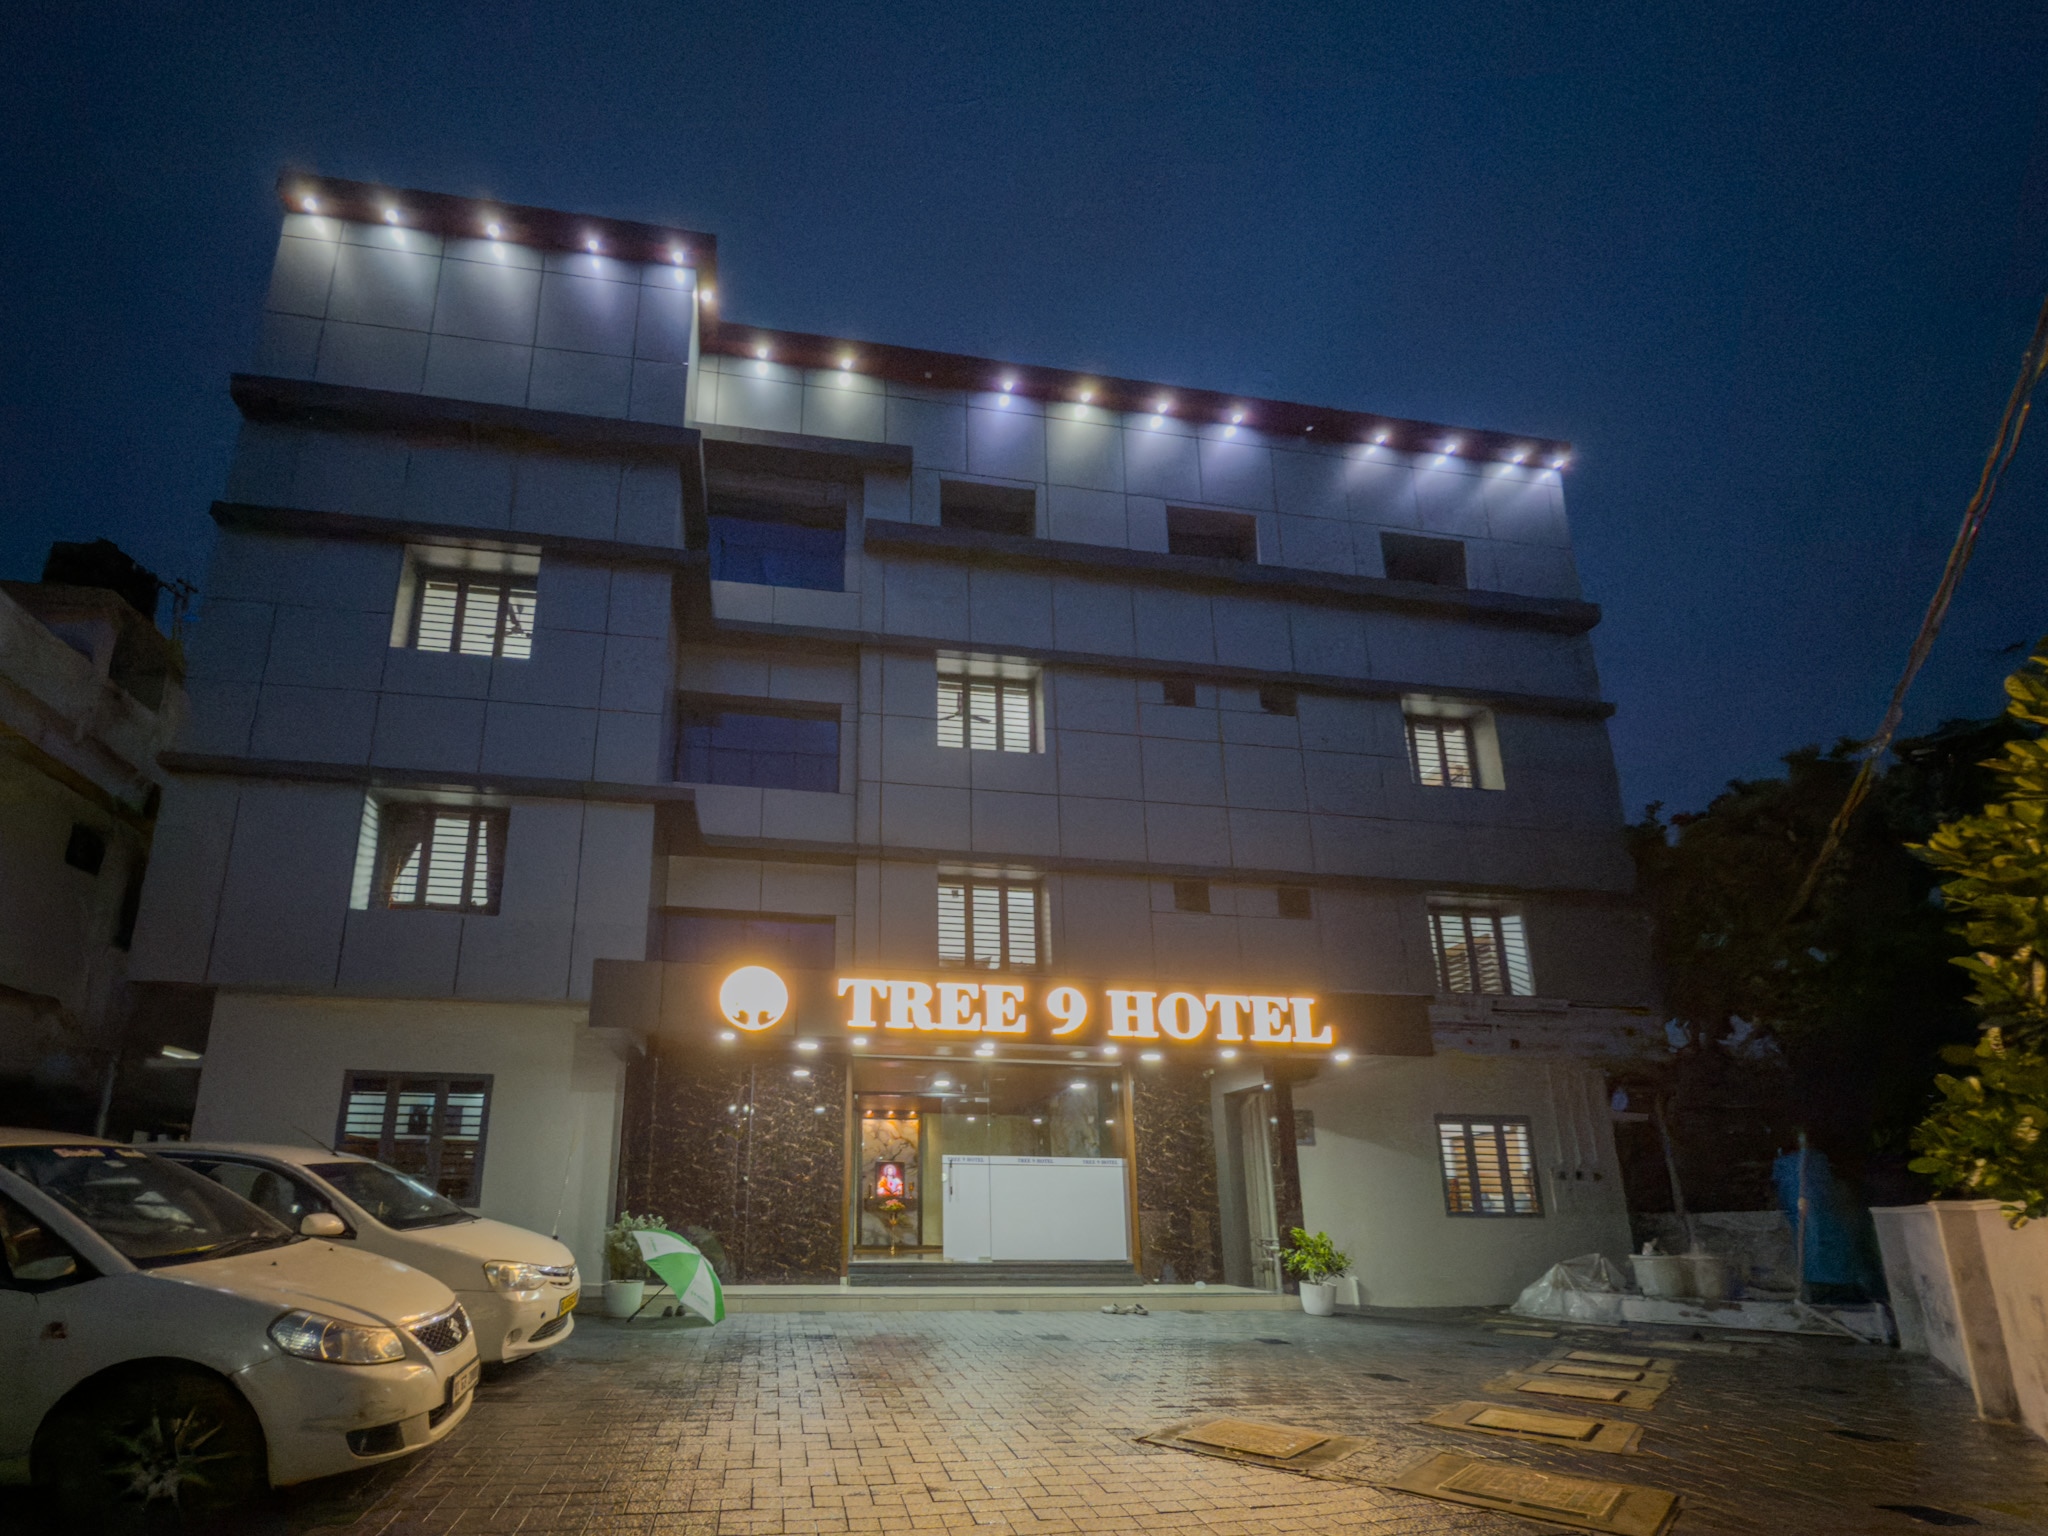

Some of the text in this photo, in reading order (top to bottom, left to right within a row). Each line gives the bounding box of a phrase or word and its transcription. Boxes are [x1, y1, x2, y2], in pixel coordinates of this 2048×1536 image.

[837, 978, 1333, 1044] TREE 9 HOTEL
